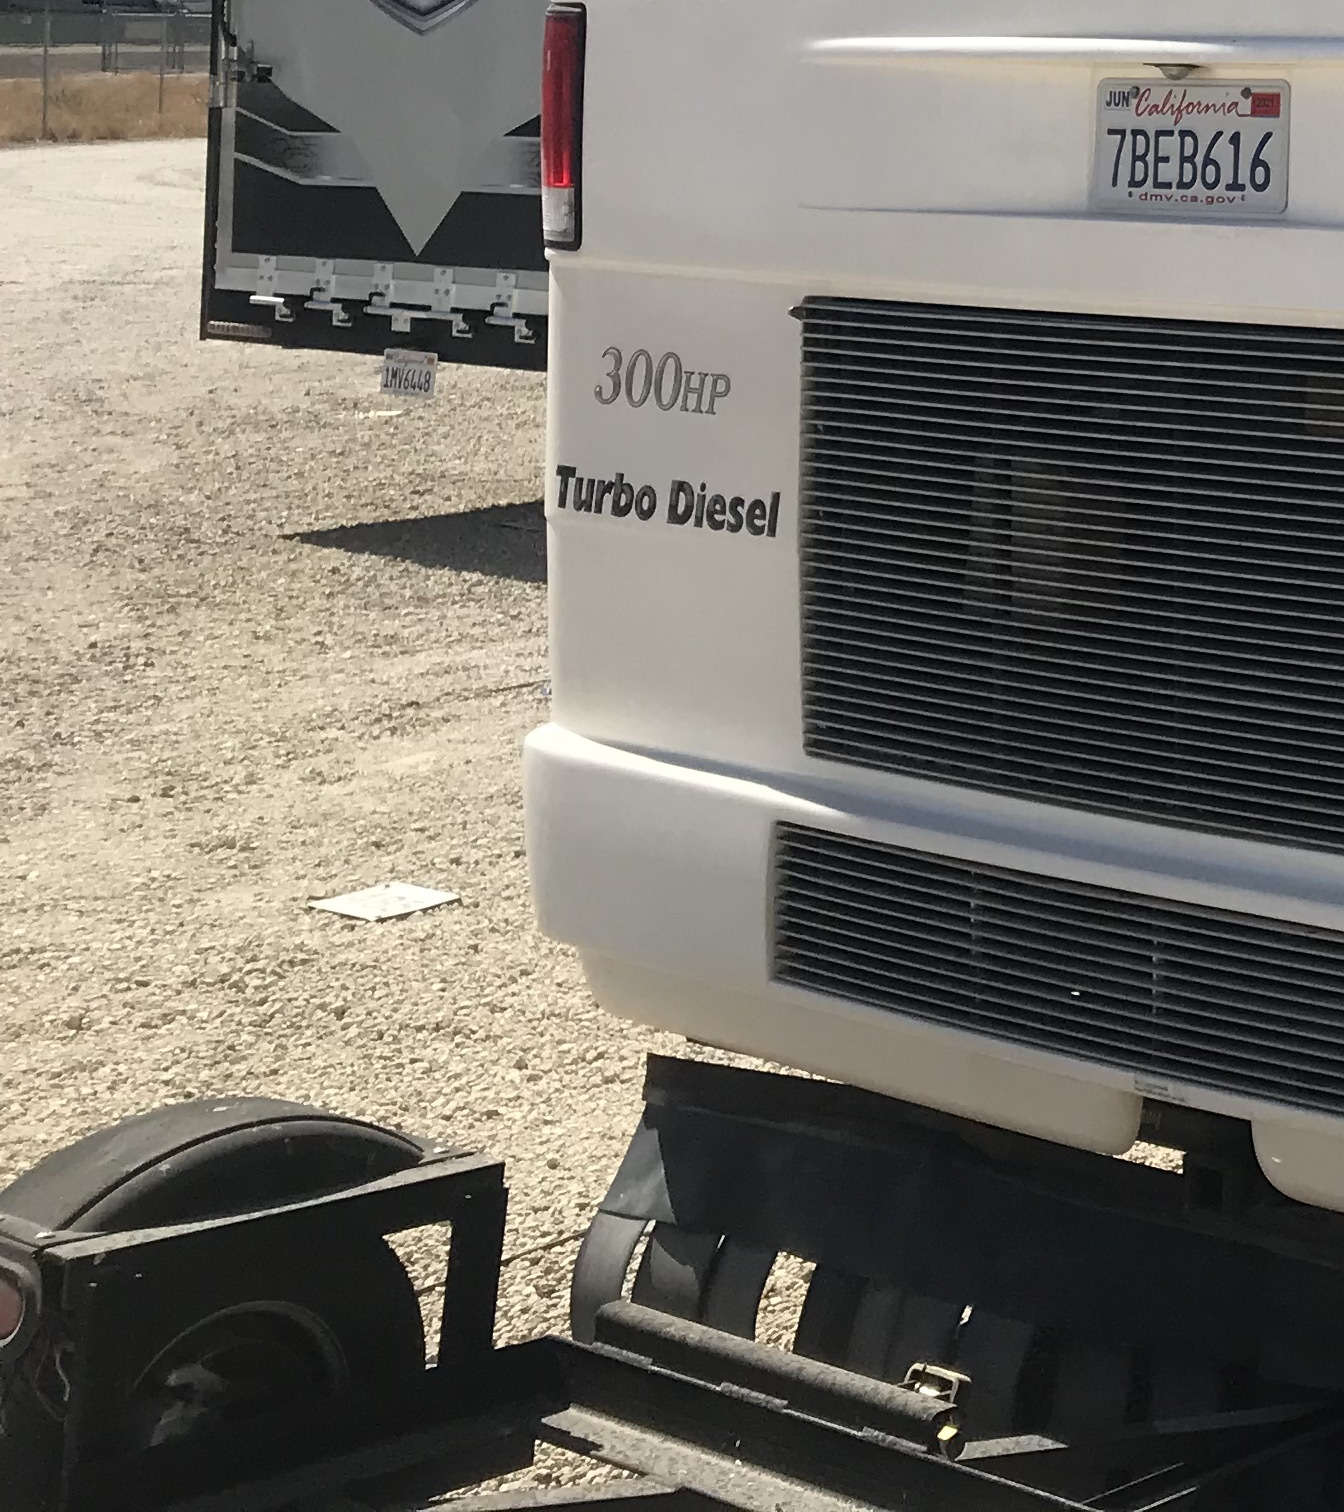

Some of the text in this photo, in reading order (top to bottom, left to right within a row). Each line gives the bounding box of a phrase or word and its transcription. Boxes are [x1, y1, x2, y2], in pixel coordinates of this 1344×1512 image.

[1106, 90, 1130, 108] JUN
[1135, 88, 1251, 127] California
[1106, 128, 1273, 193] 7BEB616
[1138, 191, 1236, 205] dmv.ca.gov
[383, 367, 432, 393] 1MV6448
[594, 346, 731, 415] 300HP
[556, 465, 781, 537] Turbo Diesel
